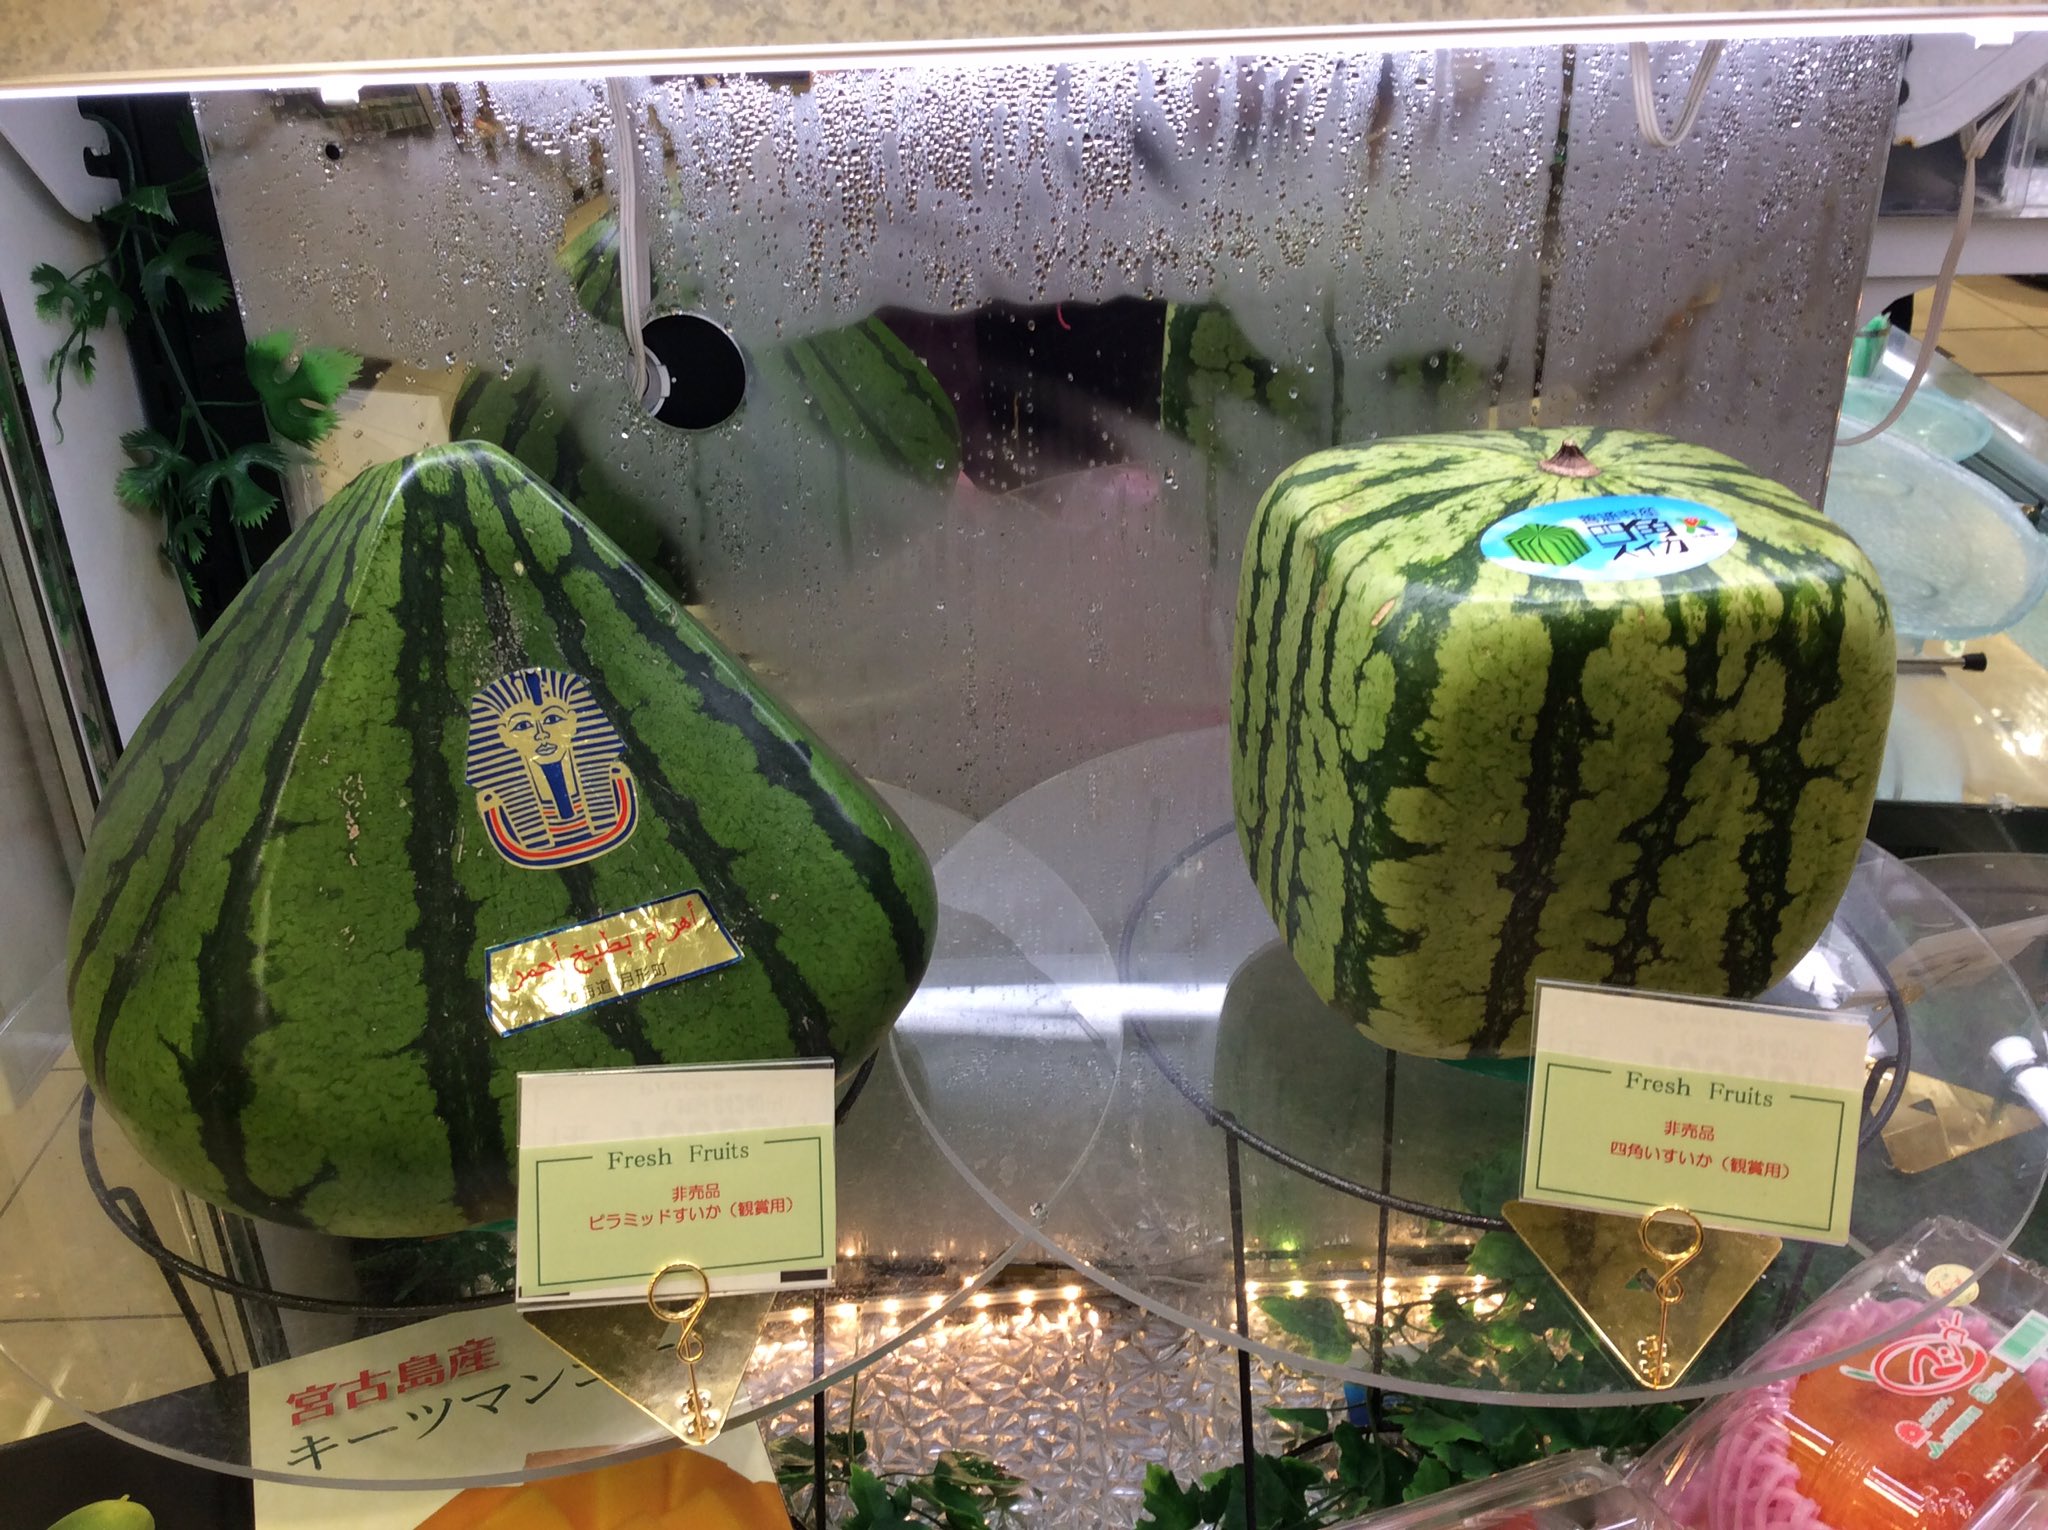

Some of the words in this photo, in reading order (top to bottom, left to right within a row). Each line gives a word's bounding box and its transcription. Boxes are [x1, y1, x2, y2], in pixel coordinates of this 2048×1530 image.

[1626, 1070, 1691, 1098] Fresh
[1709, 1081, 1774, 1108] Fruits
[1664, 1120, 1715, 1142] 非売品
[607, 1147, 672, 1170] Fresh
[689, 1141, 750, 1163] Fruits
[671, 1182, 721, 1202] 非売品
[286, 1336, 502, 1427] 宮古島産
